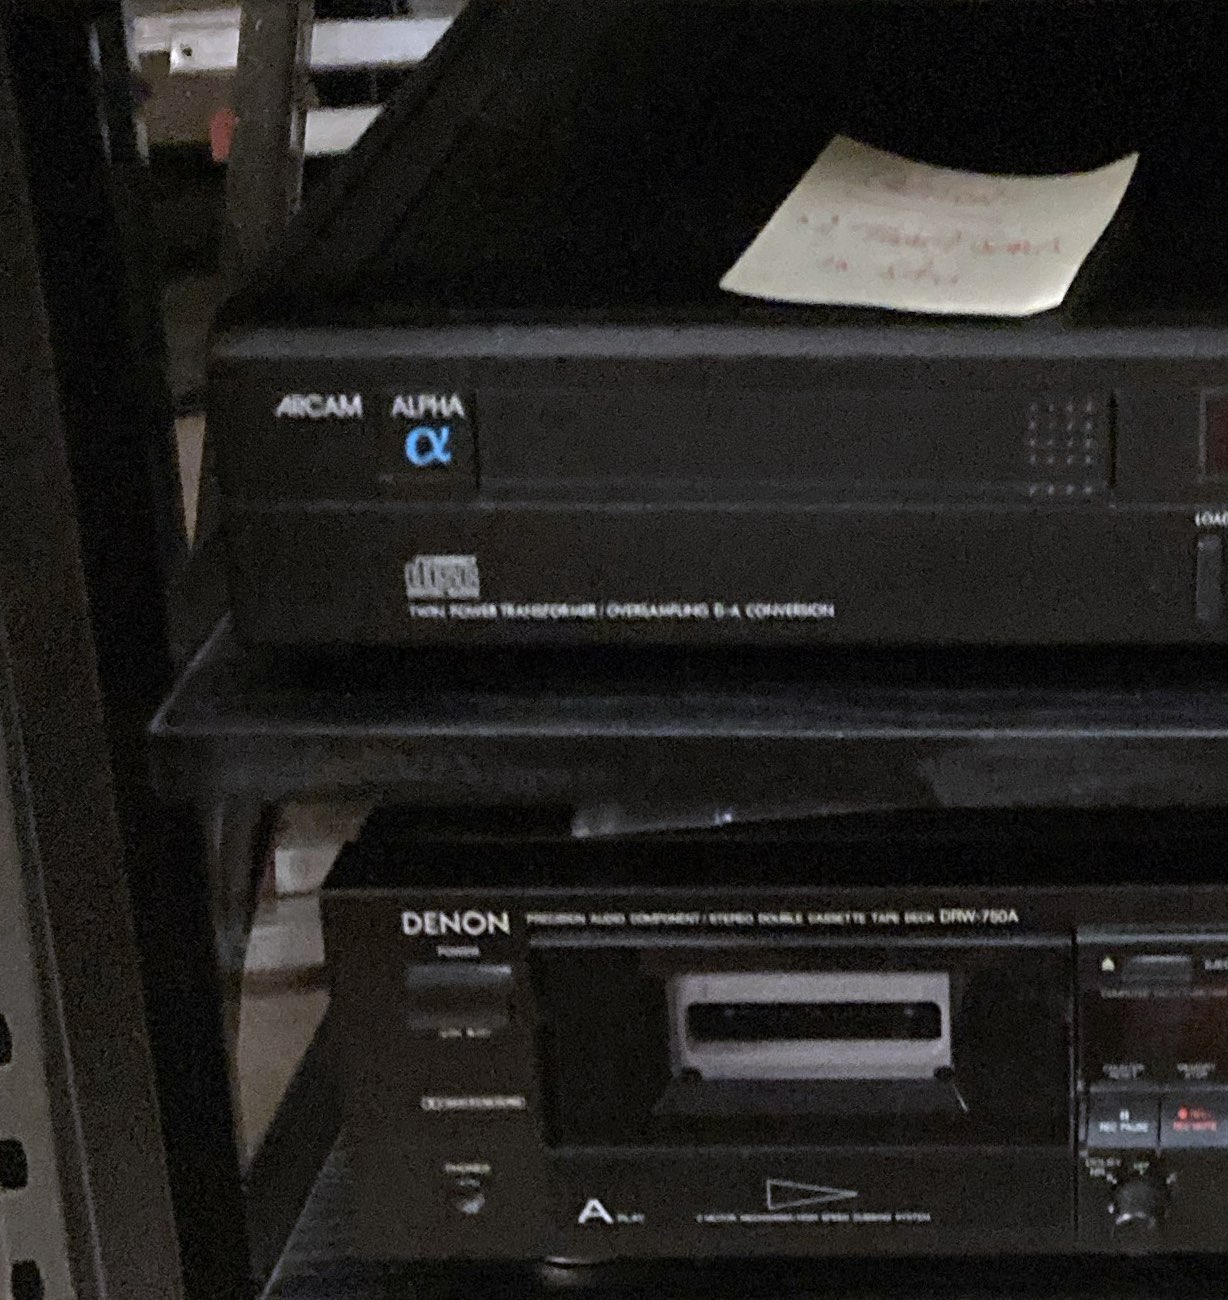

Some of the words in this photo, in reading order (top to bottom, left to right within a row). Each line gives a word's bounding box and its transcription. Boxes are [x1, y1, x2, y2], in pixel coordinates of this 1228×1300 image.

[275, 393, 363, 418] ARCAM
[392, 393, 465, 418] ALPHA
[450, 602, 498, 619] POWER
[402, 910, 511, 936] DENON
[577, 1198, 614, 1224] A
